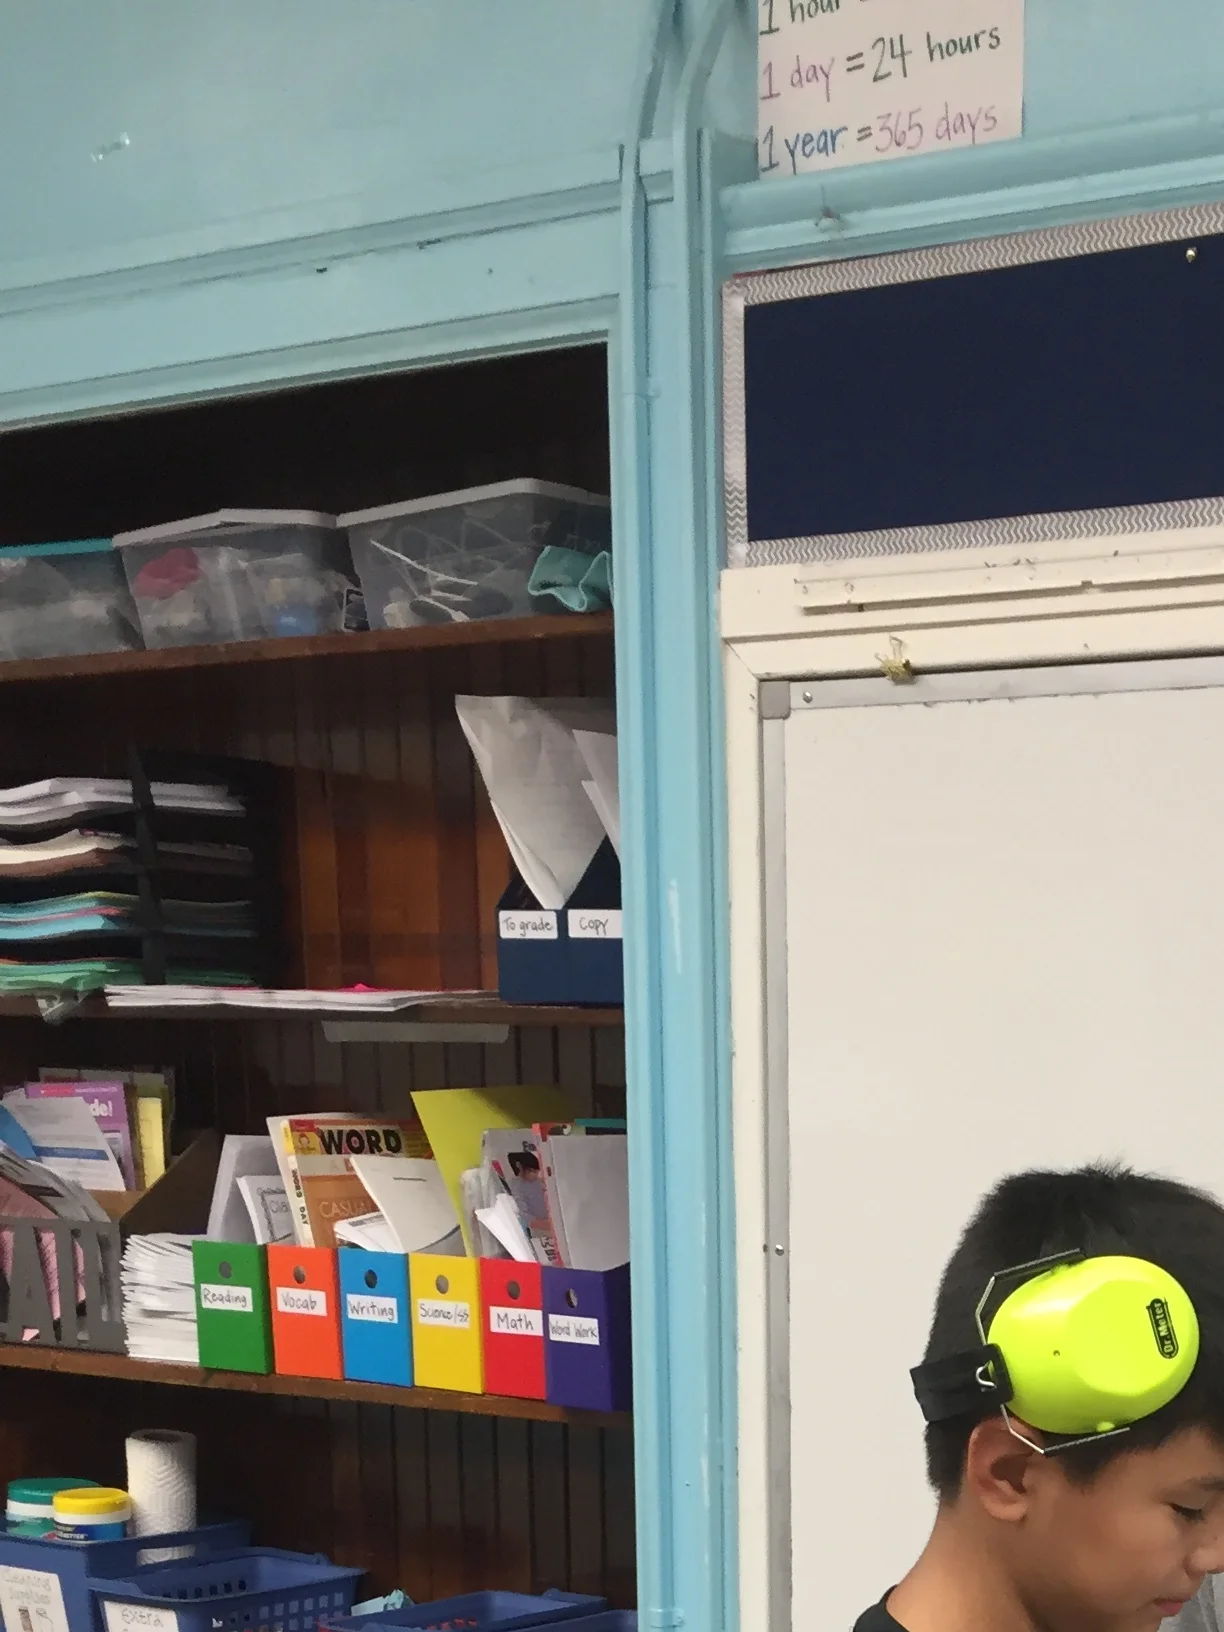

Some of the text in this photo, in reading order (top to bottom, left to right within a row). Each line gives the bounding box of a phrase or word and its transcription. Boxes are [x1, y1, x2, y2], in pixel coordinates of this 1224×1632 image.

[759, 0, 780, 35] 1
[760, 61, 781, 100] 1
[789, 55, 835, 102] day
[926, 26, 1001, 62] hours
[759, 125, 780, 172] 1
[784, 124, 848, 175] year
[935, 101, 997, 145] days
[502, 917, 552, 936] To grade
[318, 1128, 402, 1155] WORD
[202, 1287, 247, 1308] Reading
[282, 1292, 317, 1311] Vocab
[350, 1300, 395, 1321] Writing
[497, 1312, 534, 1332] Math
[121, 1608, 164, 1628] Extra
